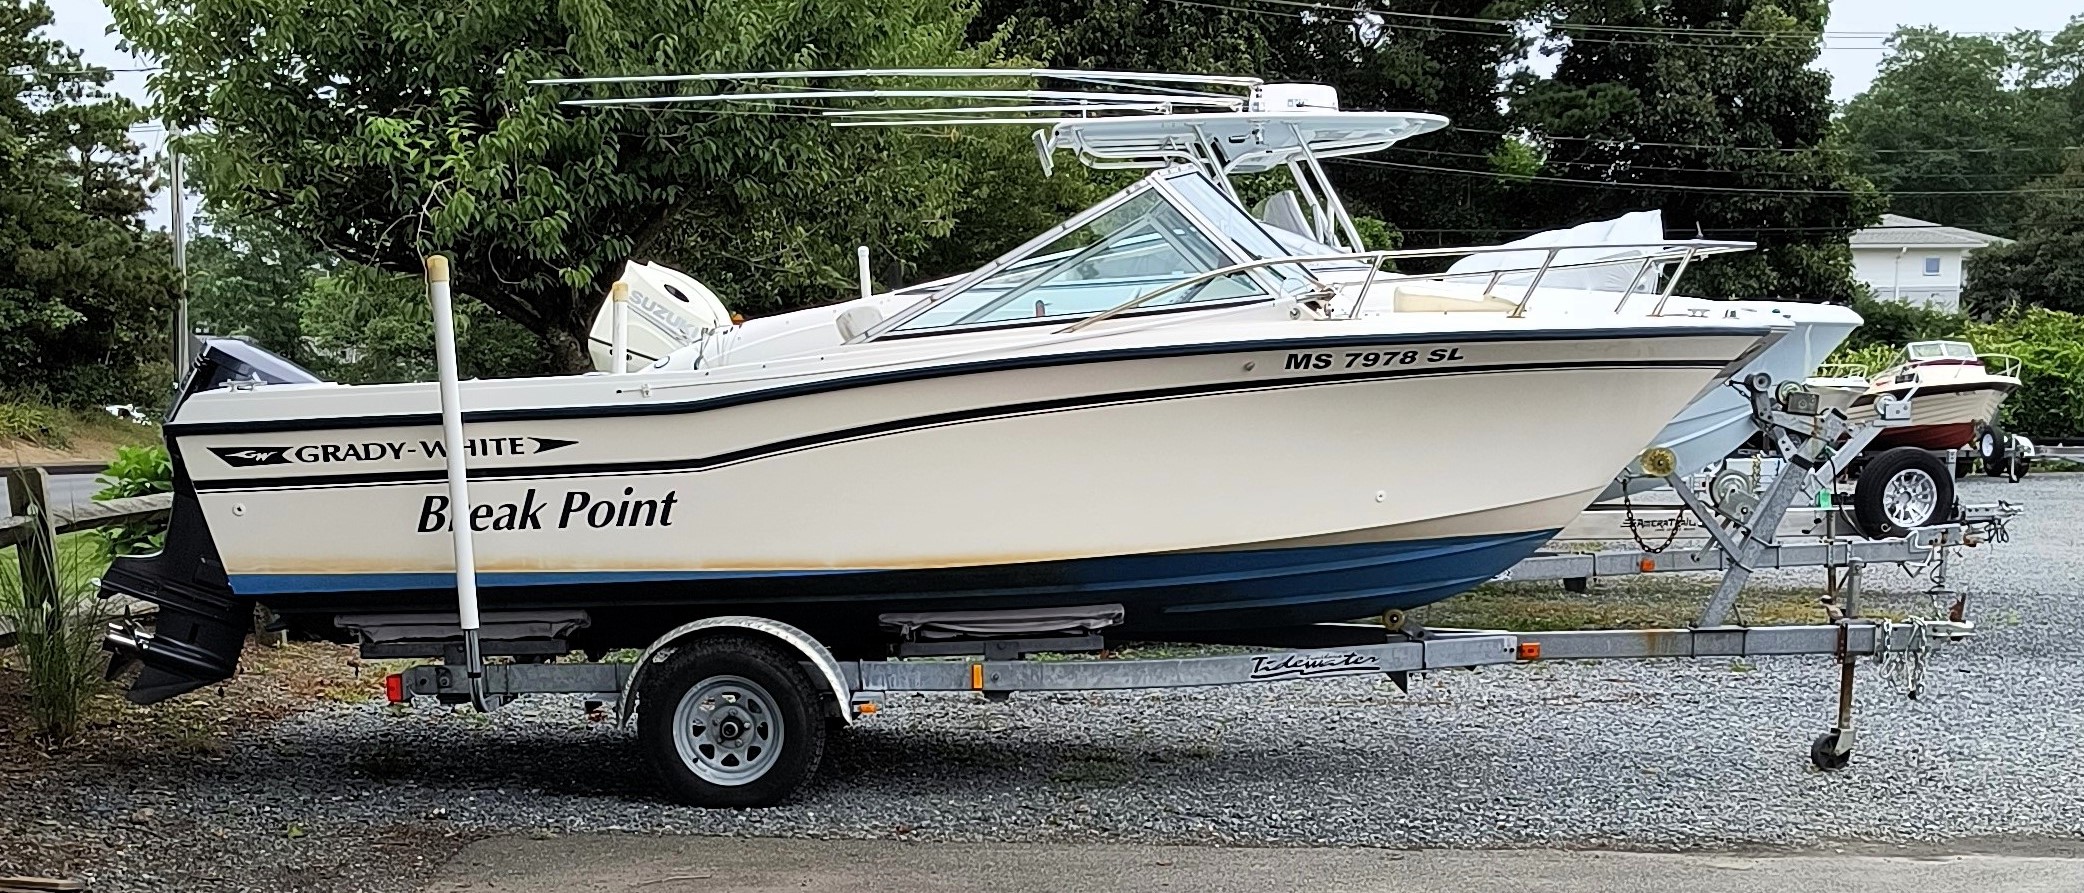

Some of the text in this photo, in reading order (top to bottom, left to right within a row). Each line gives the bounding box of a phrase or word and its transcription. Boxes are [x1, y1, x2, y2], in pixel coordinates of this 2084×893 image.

[628, 290, 699, 339] SUZUKI
[1284, 347, 1464, 370] MS 7978 SL
[417, 486, 678, 533] Beak Point
[1251, 651, 1379, 673] Tidewater
